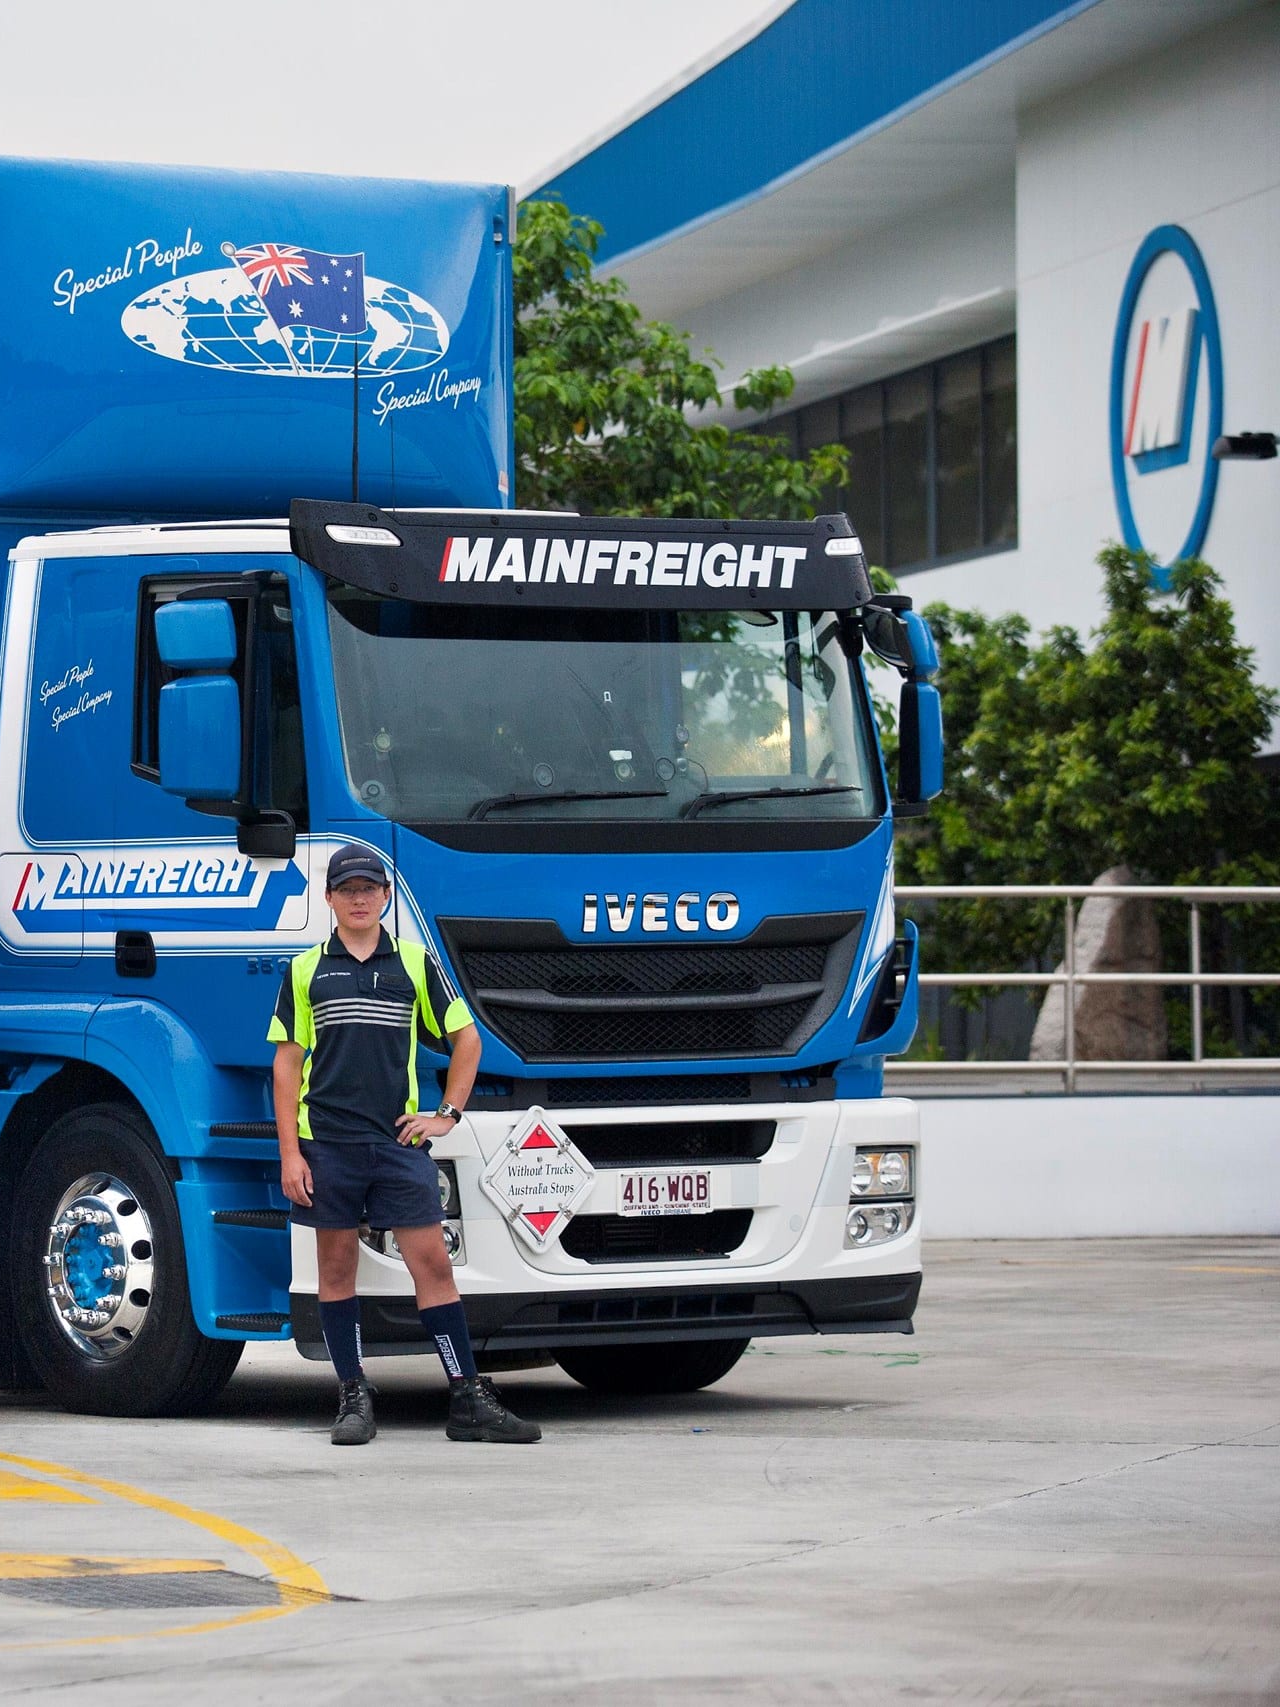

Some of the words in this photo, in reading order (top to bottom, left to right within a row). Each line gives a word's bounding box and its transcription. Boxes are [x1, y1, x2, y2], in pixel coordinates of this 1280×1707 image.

[53, 246, 133, 314] Special
[135, 227, 203, 276] People
[372, 372, 433, 426] Special
[435, 368, 482, 410] Company
[438, 536, 807, 589] MAINFREIGHT
[39, 670, 69, 707] Special
[68, 658, 94, 689] People
[51, 696, 82, 733] Special
[81, 690, 113, 714] Company
[12, 858, 287, 911] MAINFREIGHT
[582, 892, 740, 933] IVECO
[507, 1164, 543, 1177] Without
[545, 1163, 574, 1176] Trucks
[507, 1182, 548, 1196] Australia
[550, 1182, 575, 1197] Stops
